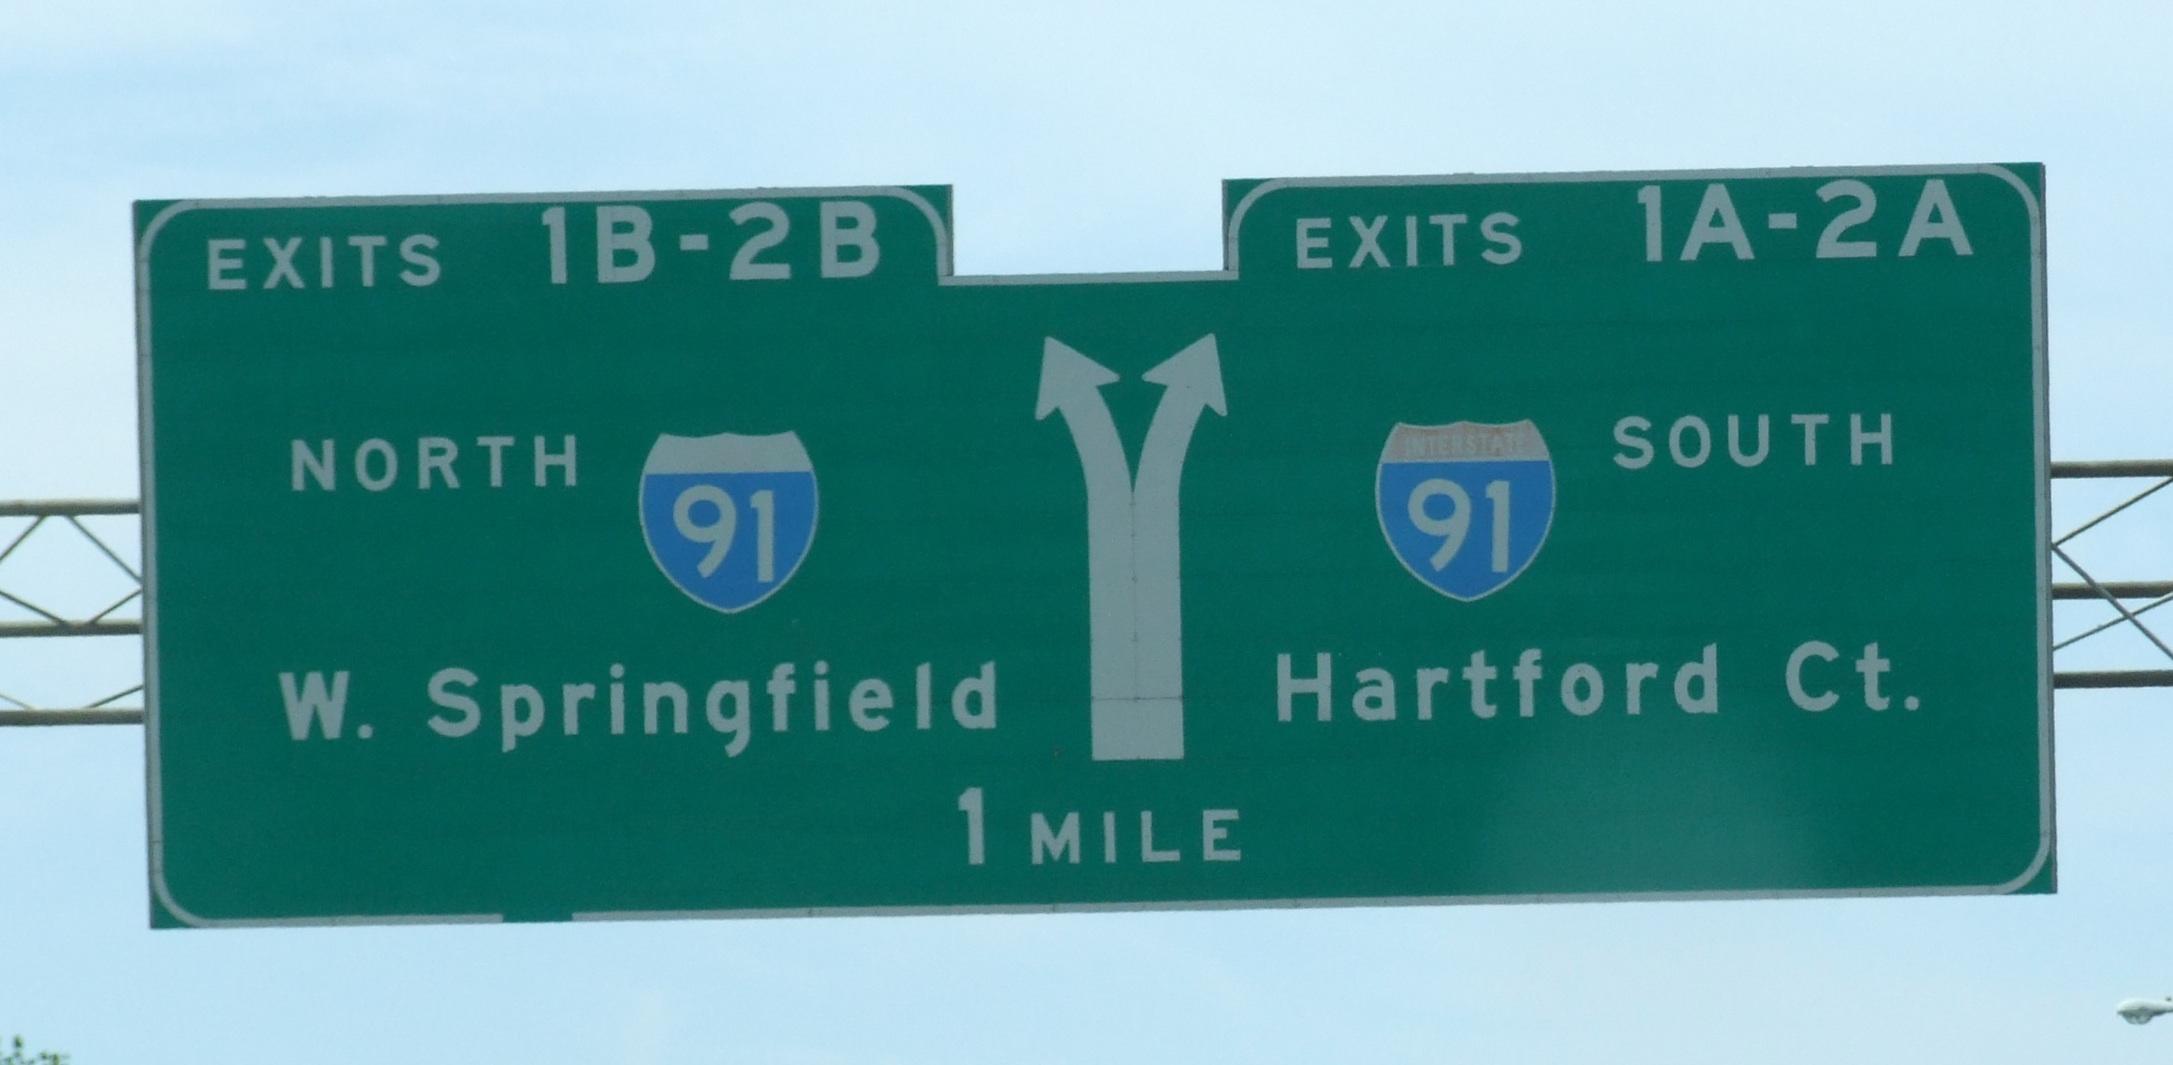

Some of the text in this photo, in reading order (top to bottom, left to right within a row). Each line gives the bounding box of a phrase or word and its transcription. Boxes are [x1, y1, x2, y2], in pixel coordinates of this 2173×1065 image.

[209, 201, 880, 290] EXITS 1B-2B
[1296, 179, 1973, 269] EXITS 1A-2A
[293, 435, 577, 491] NORTH
[1614, 414, 1892, 469] SOUTH
[673, 484, 774, 583] 91
[1407, 478, 1510, 573] 91
[280, 661, 996, 757] W. Springfield
[1277, 640, 1922, 722] Hartford Ct.
[959, 787, 1241, 865] 1 MILE
